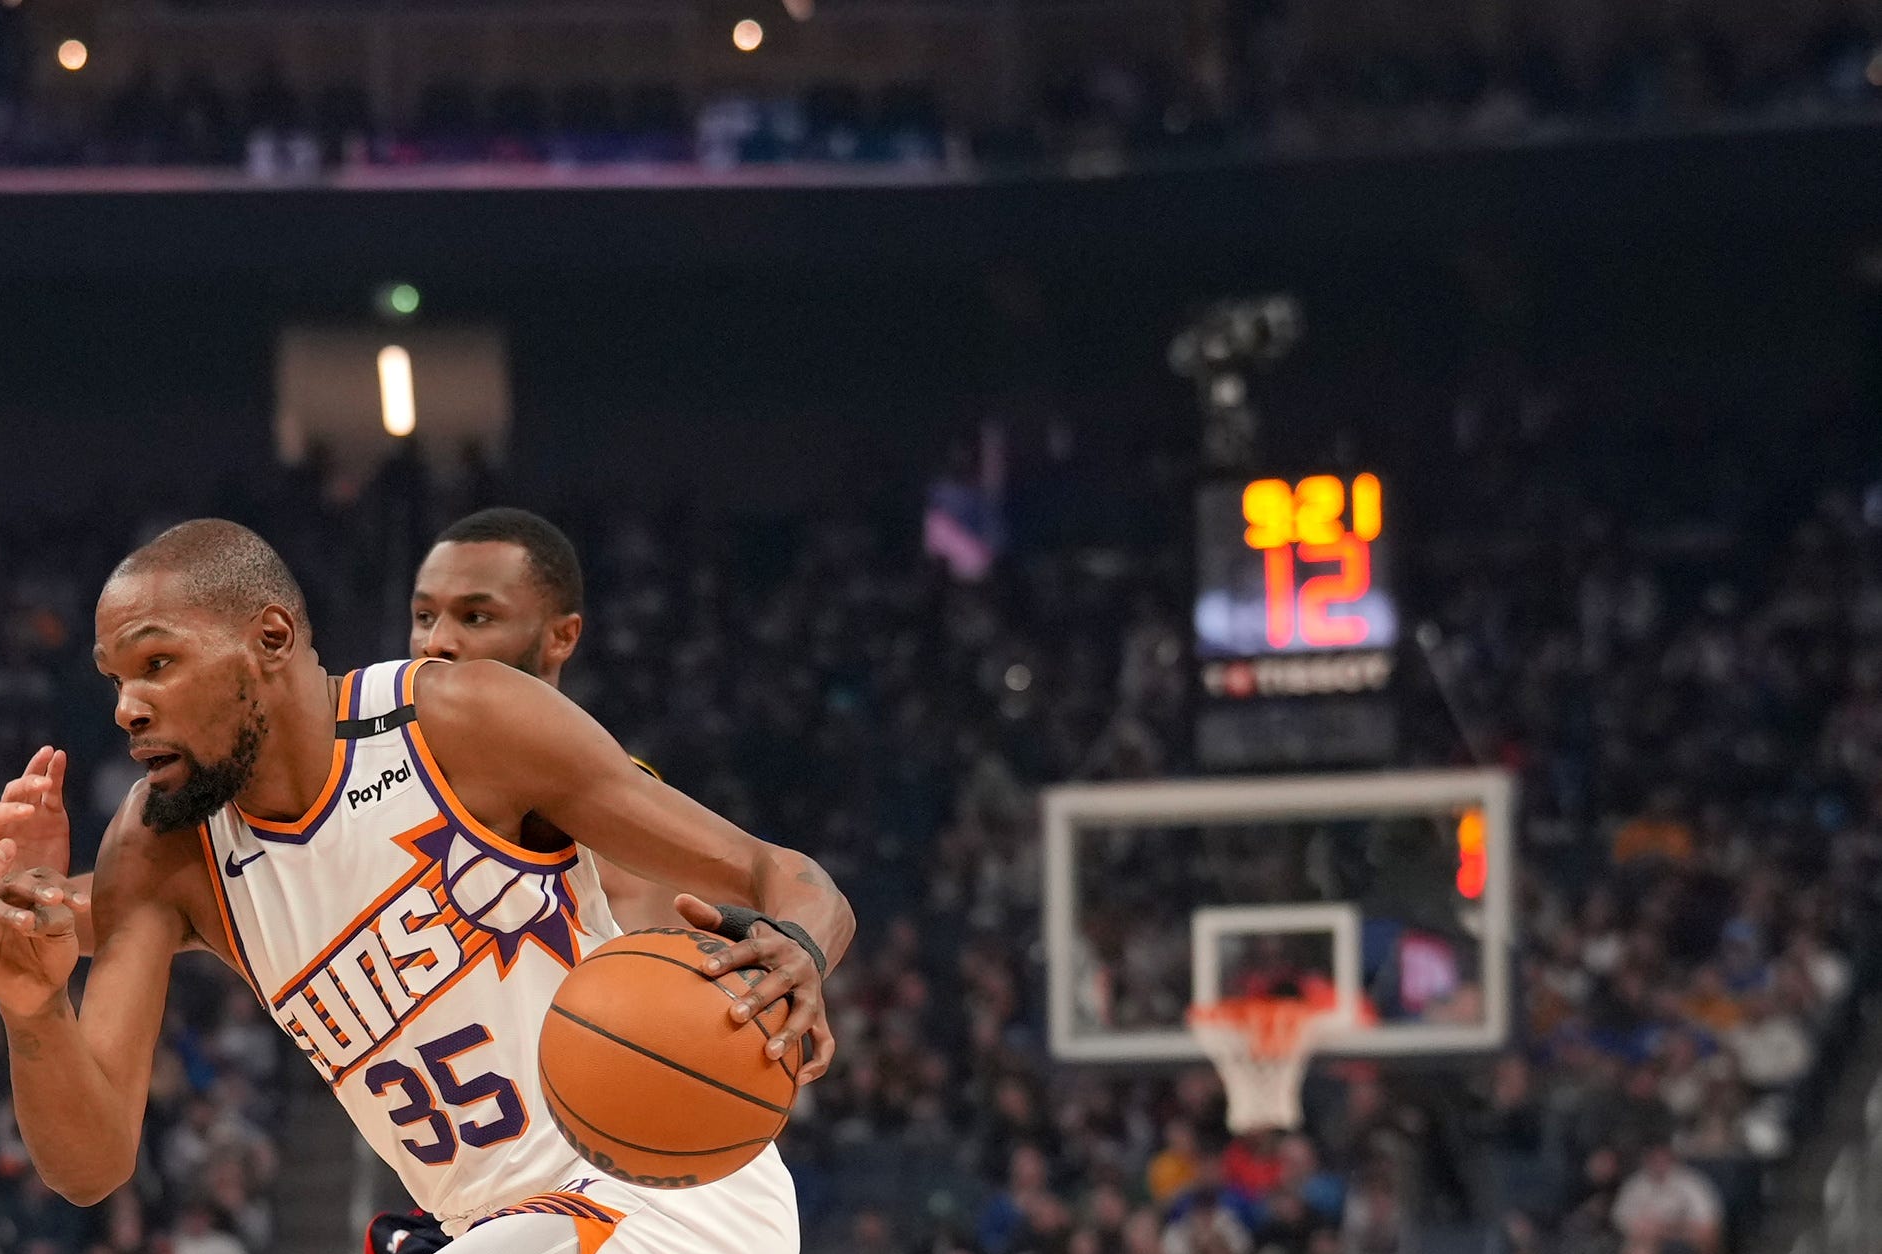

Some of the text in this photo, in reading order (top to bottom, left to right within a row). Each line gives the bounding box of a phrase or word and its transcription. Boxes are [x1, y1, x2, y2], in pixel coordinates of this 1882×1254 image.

[1264, 531, 1370, 648] 12
[375, 717, 386, 733] AL
[347, 759, 411, 810] PayPal
[365, 1023, 530, 1166] 35
